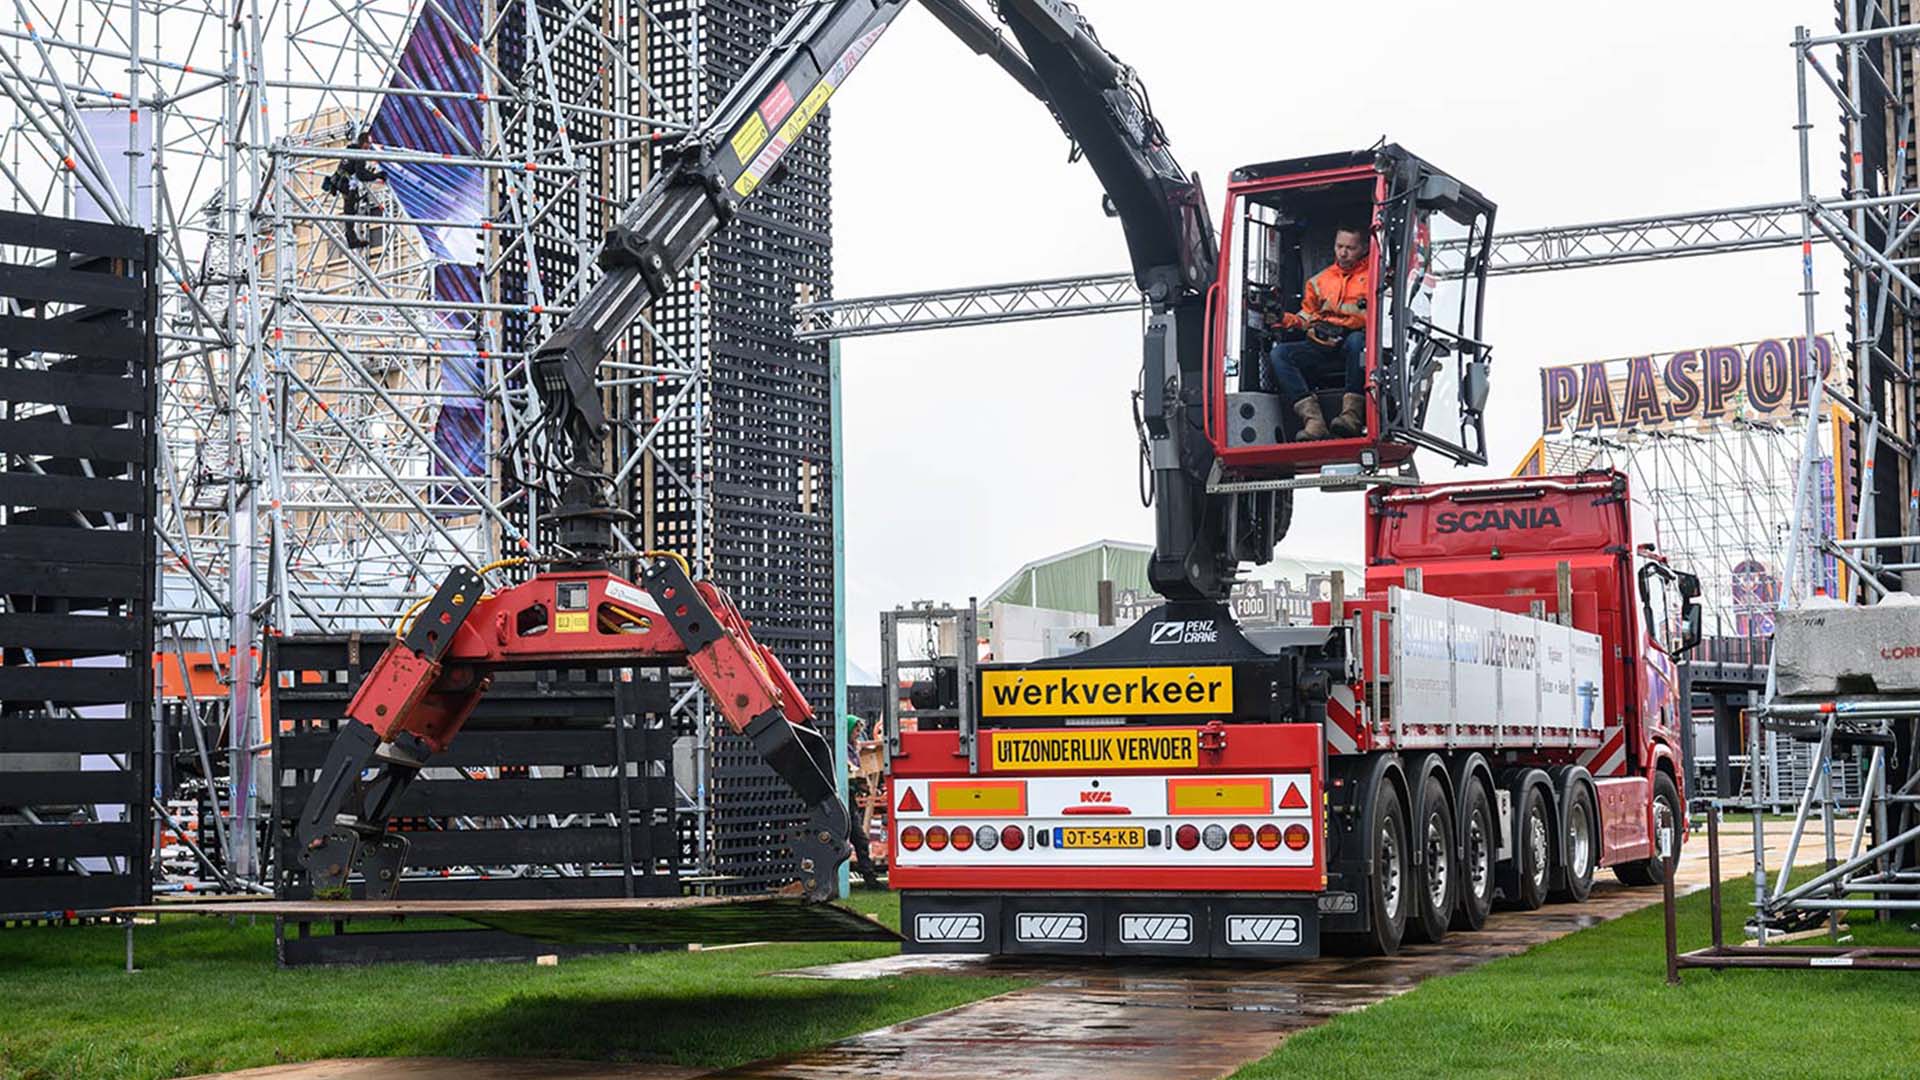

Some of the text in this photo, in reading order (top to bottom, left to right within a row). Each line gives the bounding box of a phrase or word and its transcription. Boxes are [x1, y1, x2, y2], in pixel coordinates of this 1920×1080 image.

[1541, 335, 1832, 434] PAASPOP
[1436, 507, 1561, 533] SCANIA
[1237, 598, 1265, 615] FOOD
[1184, 632, 1218, 644] CRANE
[1185, 620, 1214, 632] PENZ
[993, 675, 1222, 705] werkverkeer
[997, 736, 1193, 763] UITZONDERLIJK VERVOER
